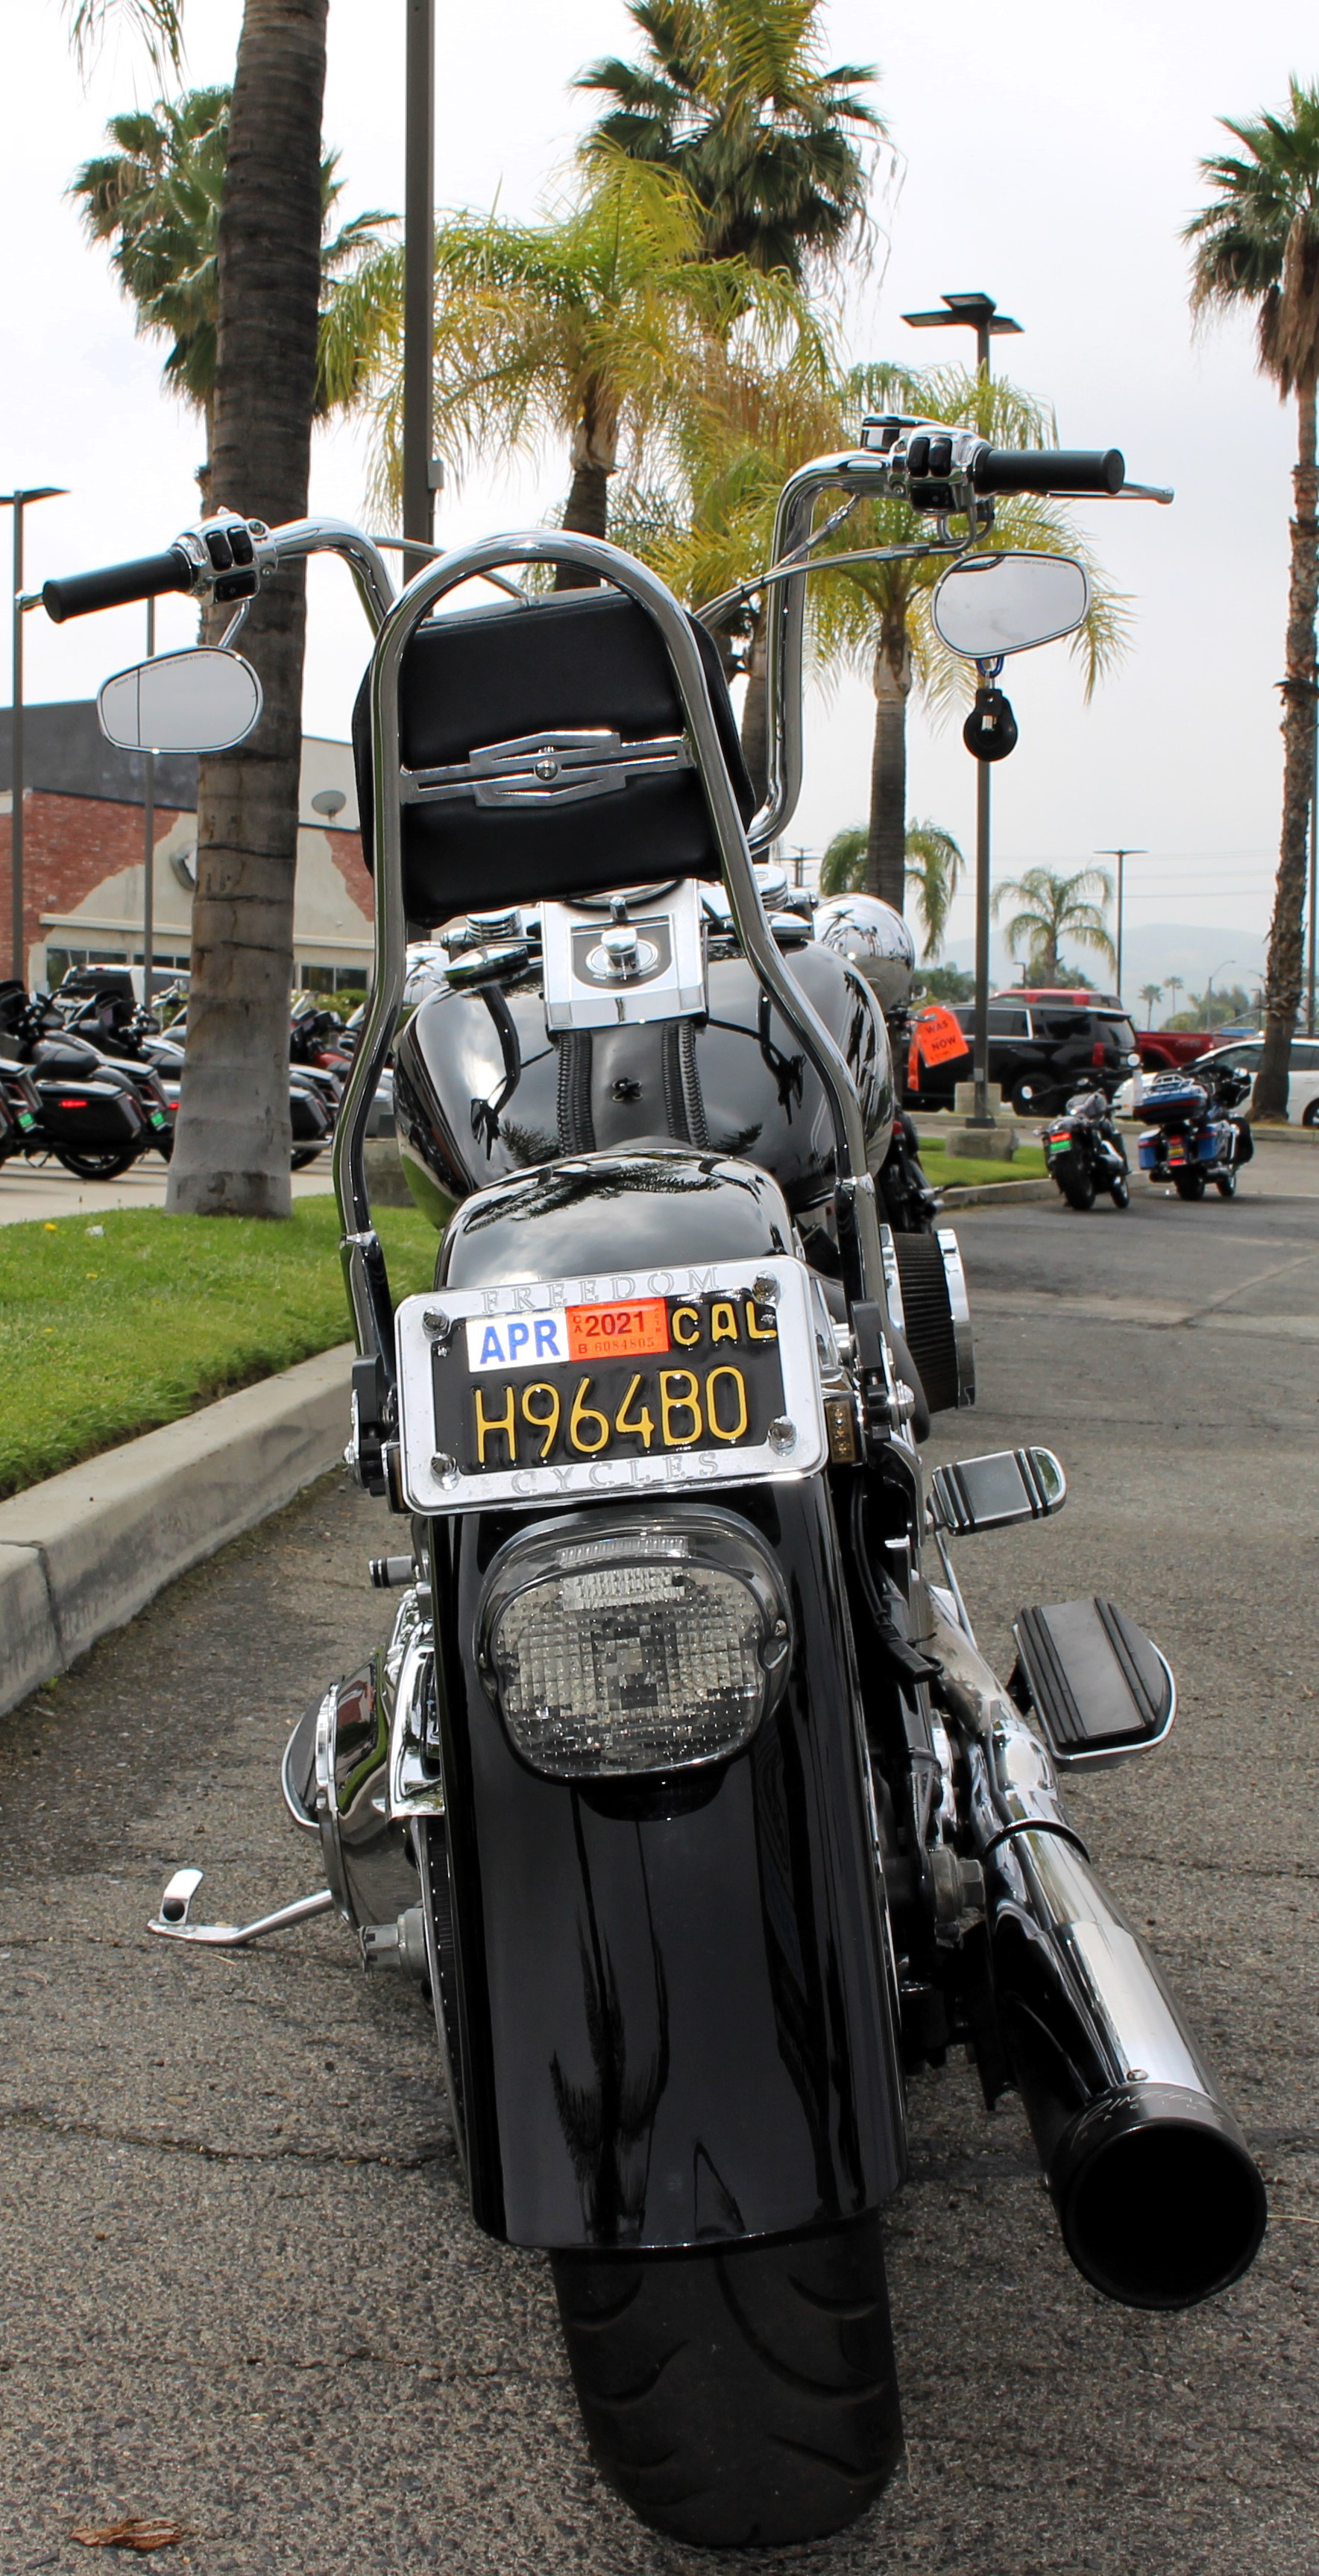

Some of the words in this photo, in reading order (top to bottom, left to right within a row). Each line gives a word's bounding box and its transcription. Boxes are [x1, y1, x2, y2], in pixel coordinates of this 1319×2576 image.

[925, 1020, 948, 1035] WAS
[931, 1035, 956, 1051] NOW
[481, 1266, 720, 1315] FREEDOM
[585, 1310, 645, 1337] 2021
[672, 1301, 778, 1345] CAL
[479, 1319, 561, 1365] APR
[578, 1343, 588, 1354] B
[511, 1452, 721, 1495] CYCLES
